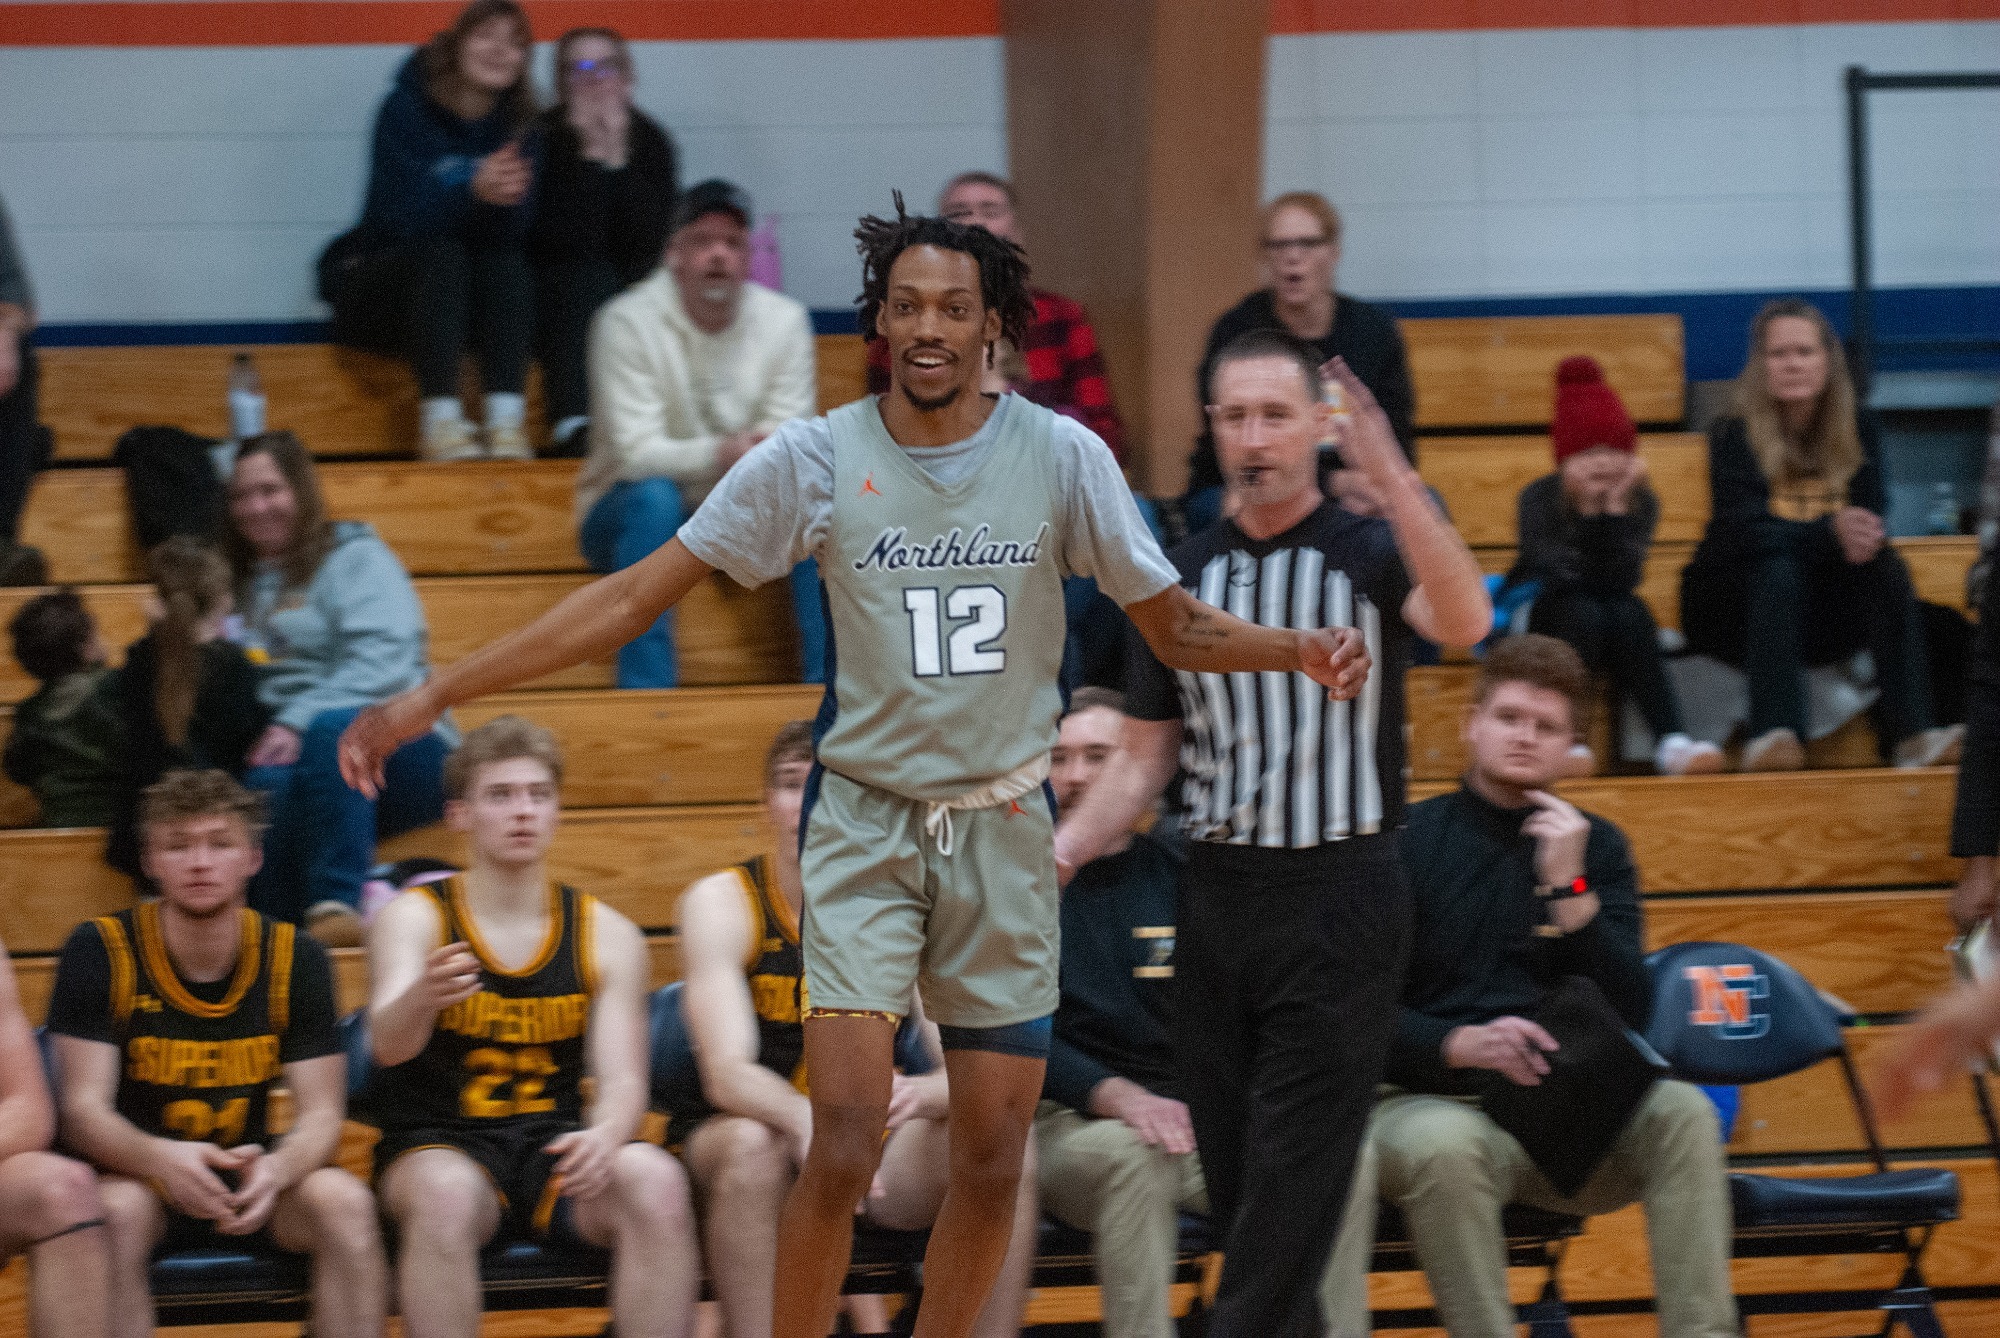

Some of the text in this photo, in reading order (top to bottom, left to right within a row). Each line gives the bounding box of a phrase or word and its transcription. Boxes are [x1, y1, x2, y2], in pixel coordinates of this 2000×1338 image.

[853, 521, 1050, 573] Northland
[903, 583, 1007, 679] 12
[459, 1047, 560, 1118] 22
